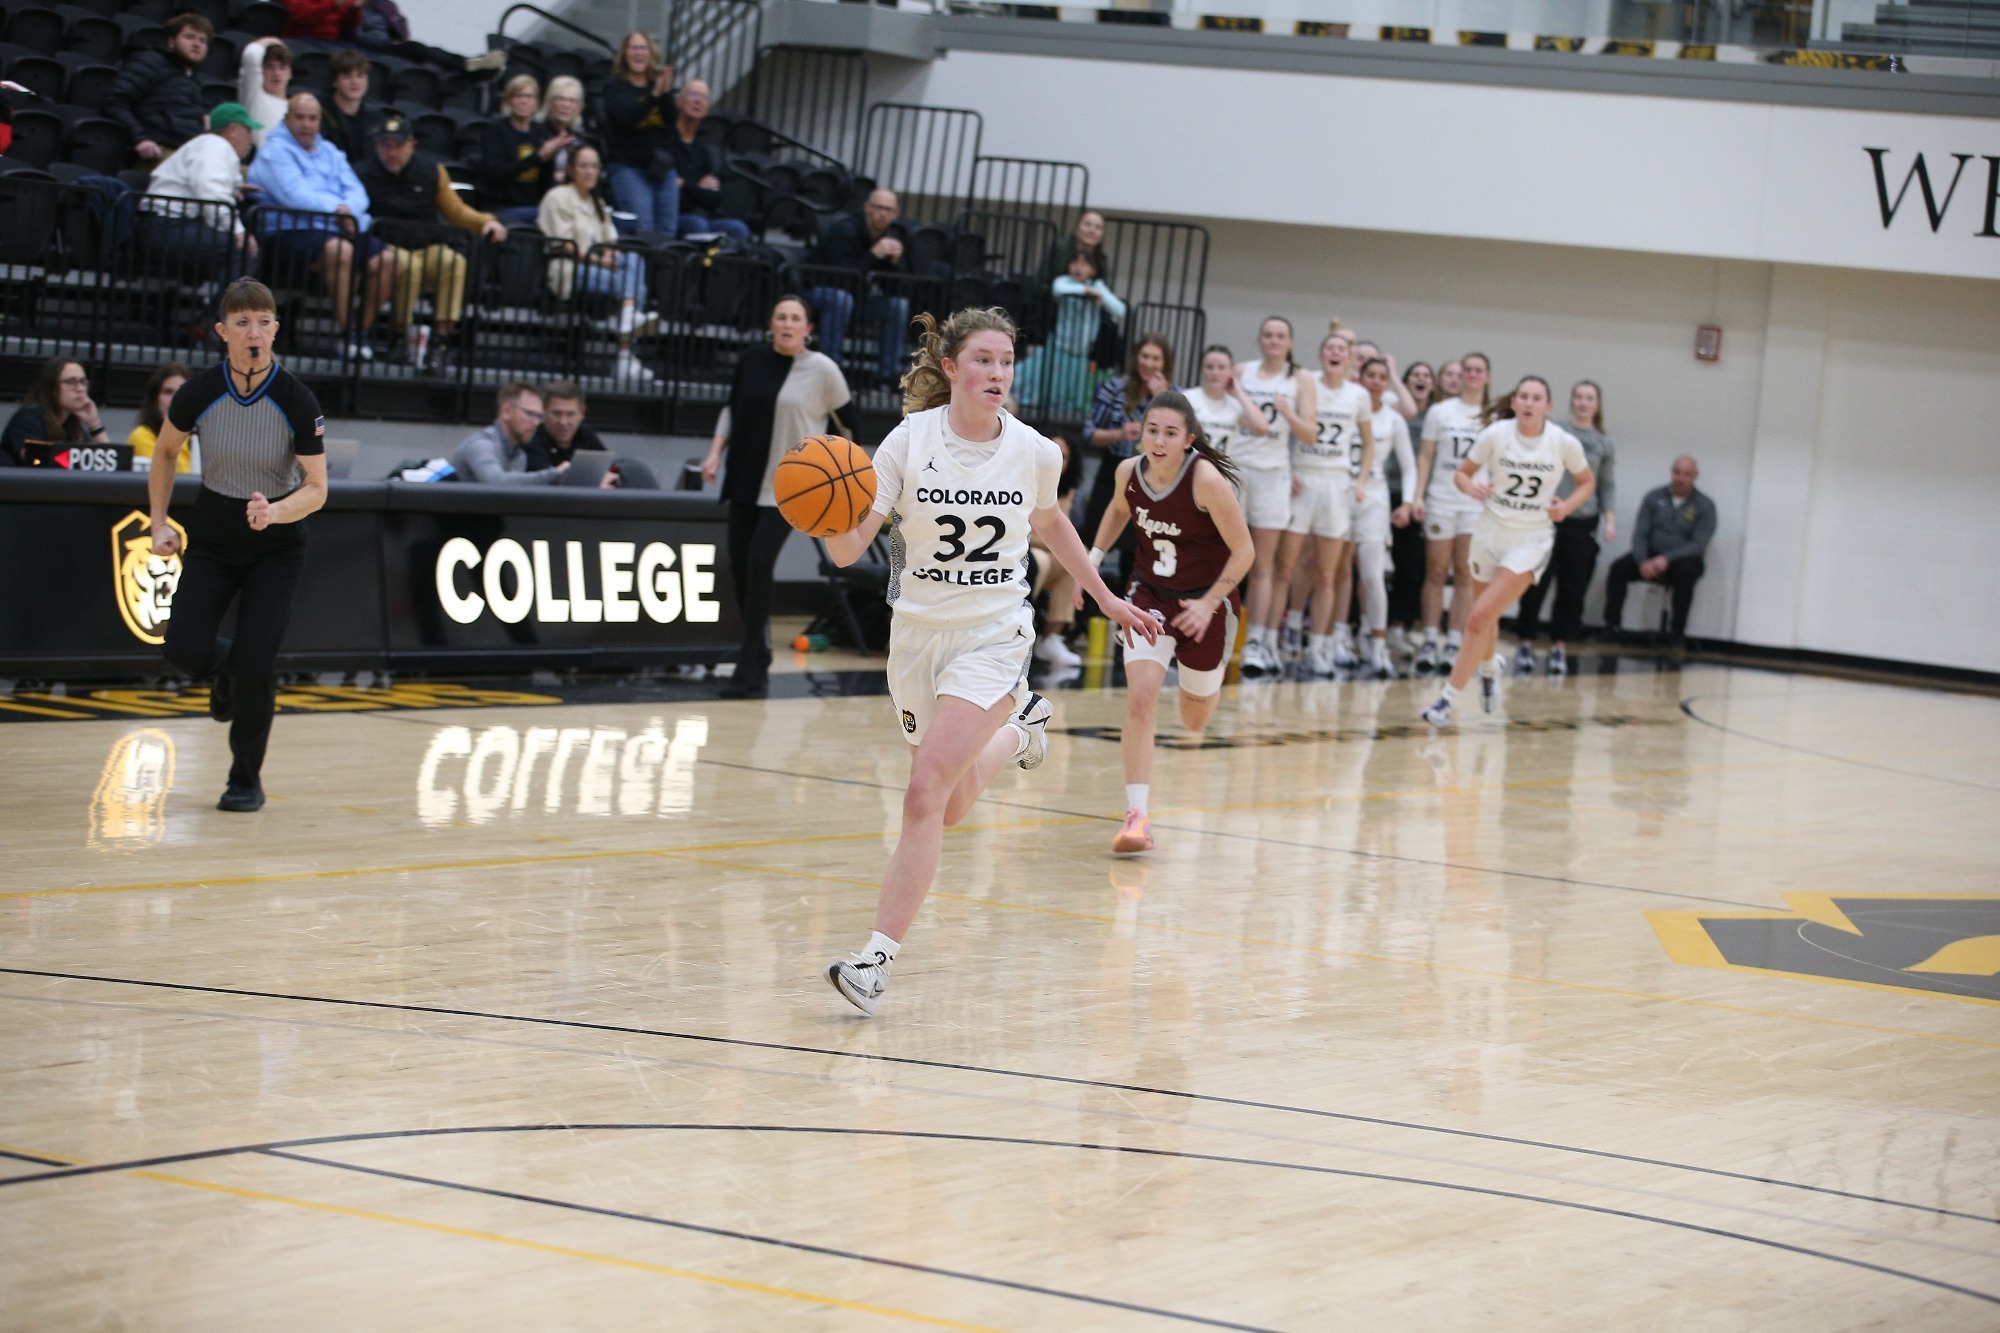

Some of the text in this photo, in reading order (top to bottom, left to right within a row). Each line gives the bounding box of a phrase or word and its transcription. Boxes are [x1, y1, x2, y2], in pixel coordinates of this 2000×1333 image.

[68, 447, 118, 472] POSS
[916, 487, 1024, 506] COLORADO
[1504, 473, 1543, 498] 23
[932, 514, 1006, 563] 32
[1135, 506, 1182, 539] Tigers
[1152, 539, 1178, 578] 3
[435, 536, 721, 624] COLLEGE
